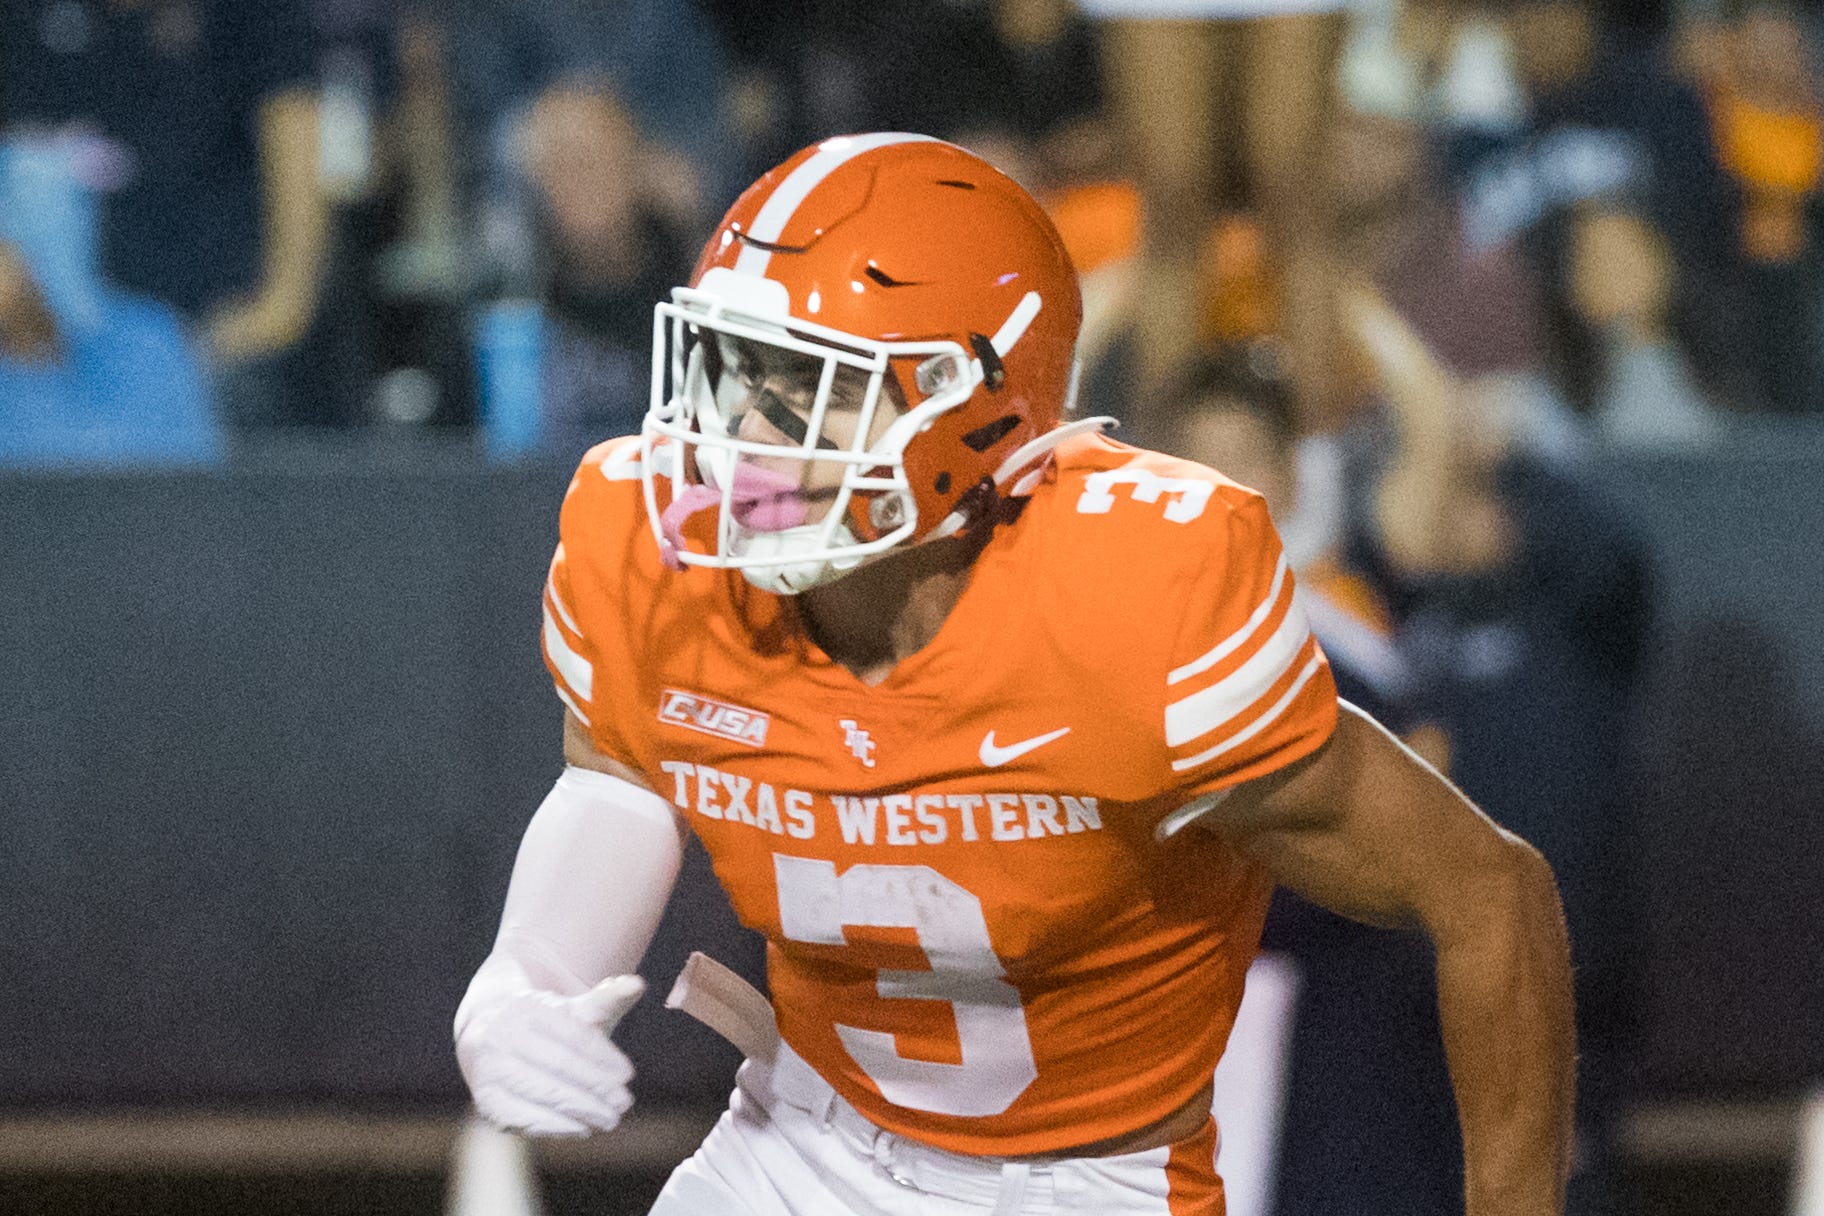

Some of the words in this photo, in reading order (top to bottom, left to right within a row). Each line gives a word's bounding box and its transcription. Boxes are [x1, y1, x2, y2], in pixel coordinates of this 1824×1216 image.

[1076, 469, 1216, 524] 3
[660, 760, 815, 840] TEXAS
[830, 793, 1103, 846] WESTERN
[772, 852, 1038, 1117] 3
